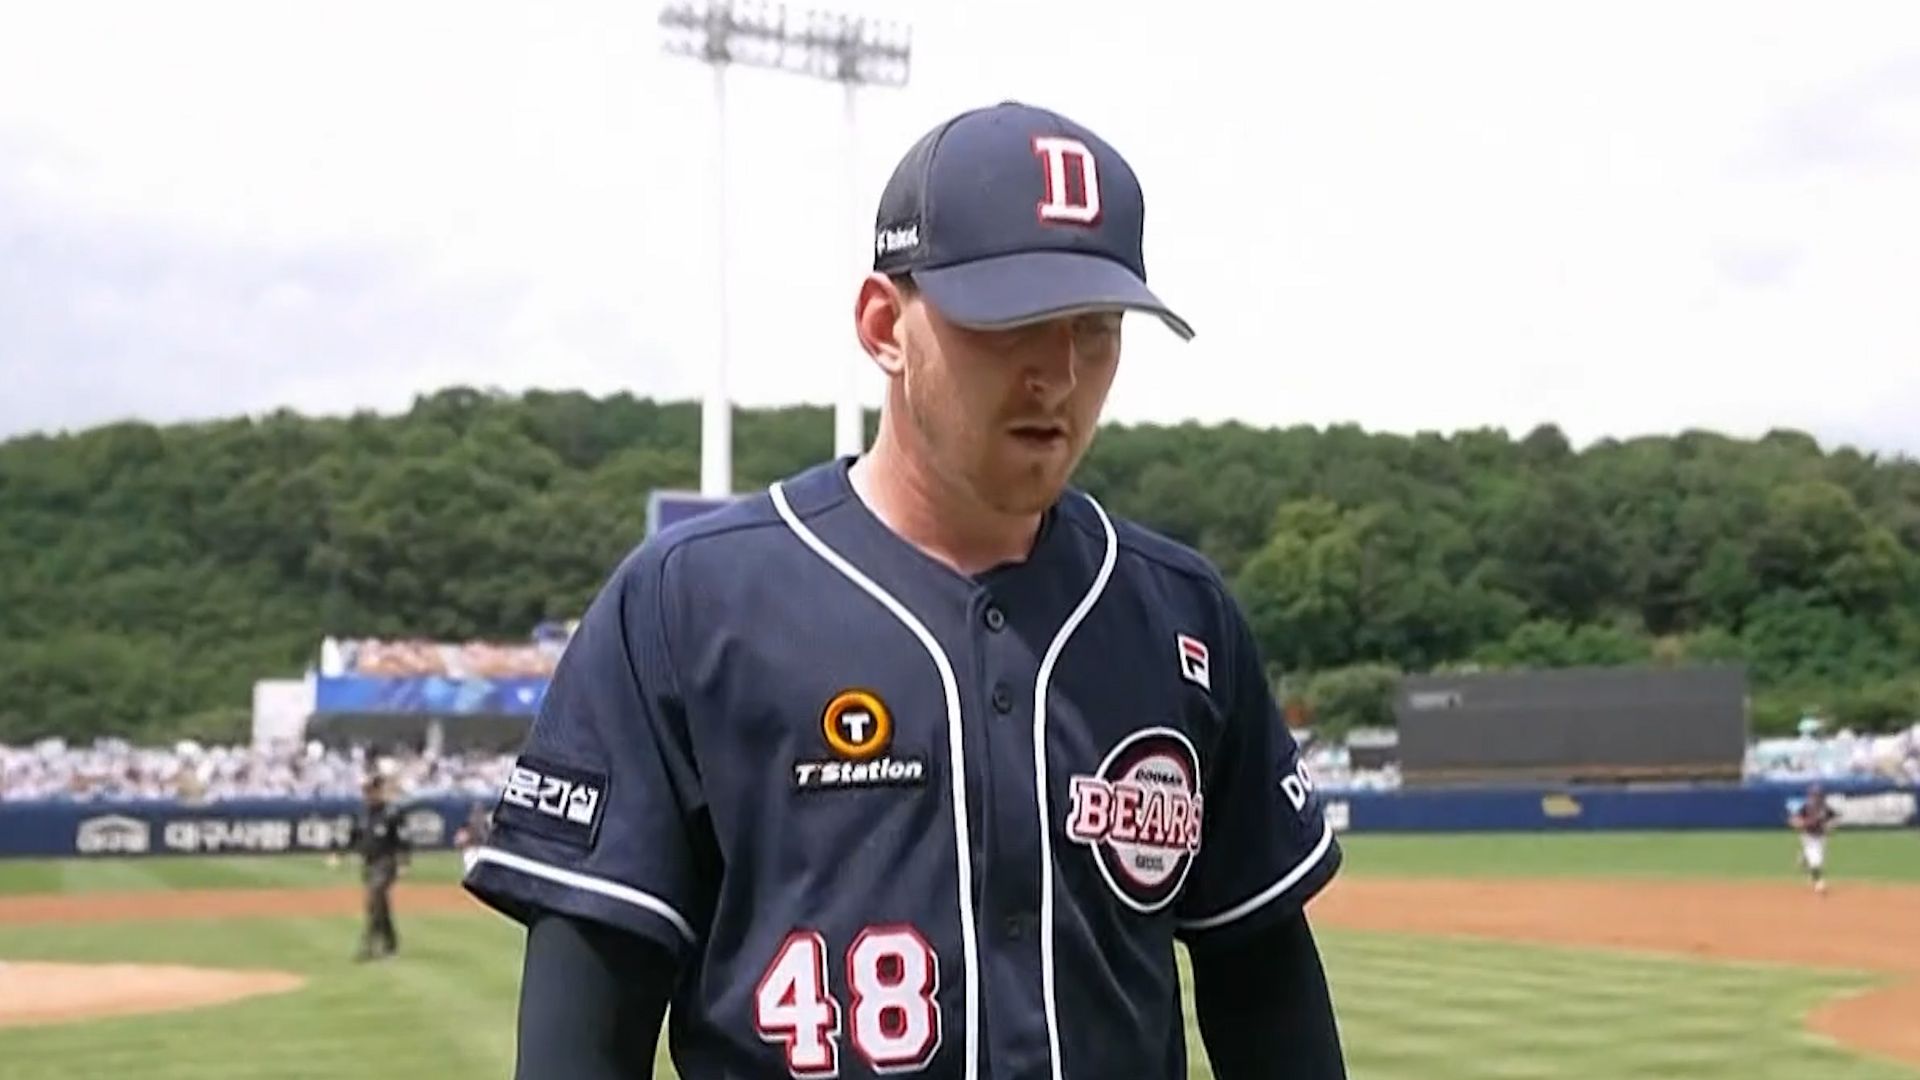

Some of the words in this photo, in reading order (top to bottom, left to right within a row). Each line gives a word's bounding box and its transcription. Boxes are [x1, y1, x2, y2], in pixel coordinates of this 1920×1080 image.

[1032, 135, 1103, 226] D
[842, 711, 870, 743] T
[1066, 775, 1203, 855] BEARS
[755, 924, 942, 1080] 48
